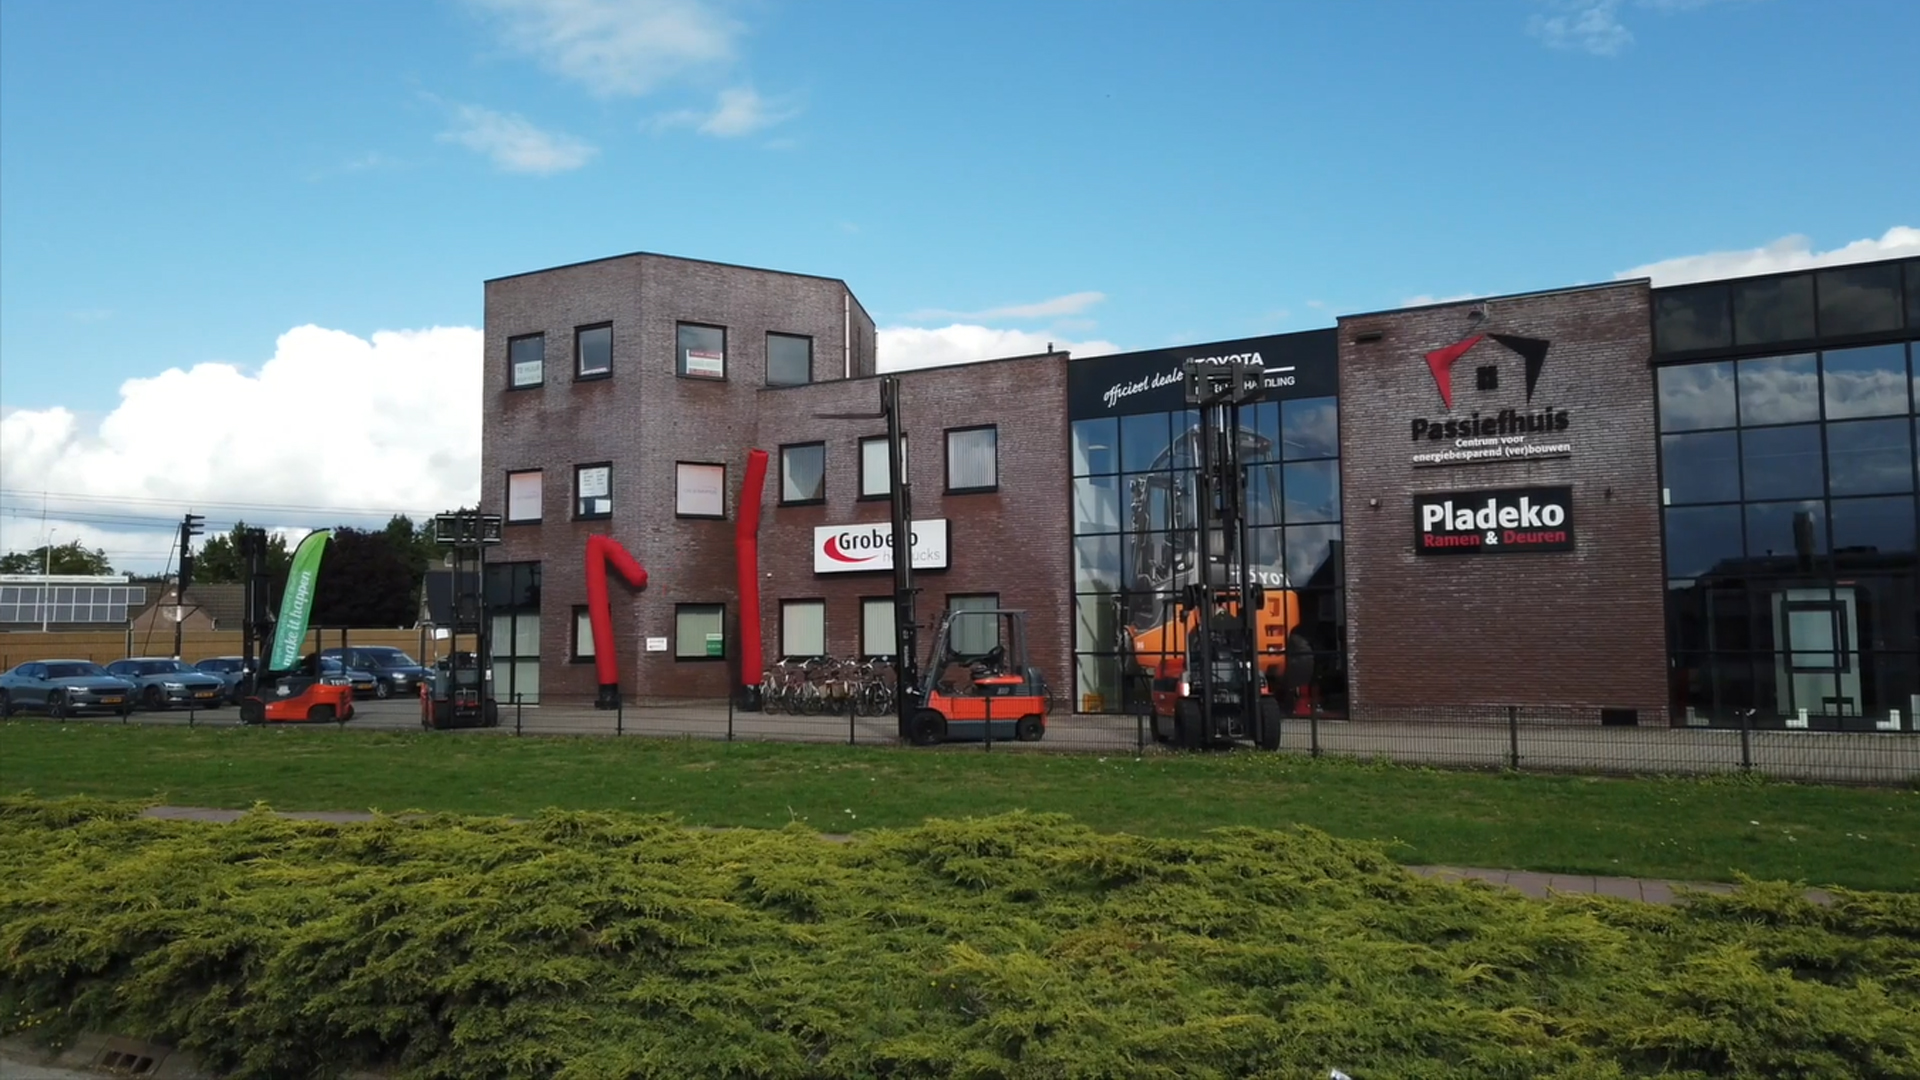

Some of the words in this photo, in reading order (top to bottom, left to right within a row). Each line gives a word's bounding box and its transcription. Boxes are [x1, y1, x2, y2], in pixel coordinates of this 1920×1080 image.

[1103, 375, 1149, 408] officieel
[1151, 367, 1185, 389] deale
[1244, 376, 1295, 390] HADLING
[1411, 406, 1570, 441] Passiefhuis
[1455, 437, 1498, 448] Centrum
[1501, 436, 1525, 444] voor
[1413, 447, 1502, 463] energiebesparend
[1505, 444, 1571, 457] (ver)bouwen
[1422, 497, 1565, 532] Pladeko
[839, 529, 918, 550] Grobeo
[1423, 533, 1480, 547] Ramen
[1485, 531, 1498, 545] &
[1503, 530, 1566, 544] Deuren
[289, 571, 312, 619] happen
[287, 619, 300, 631] it
[283, 631, 299, 667] make
